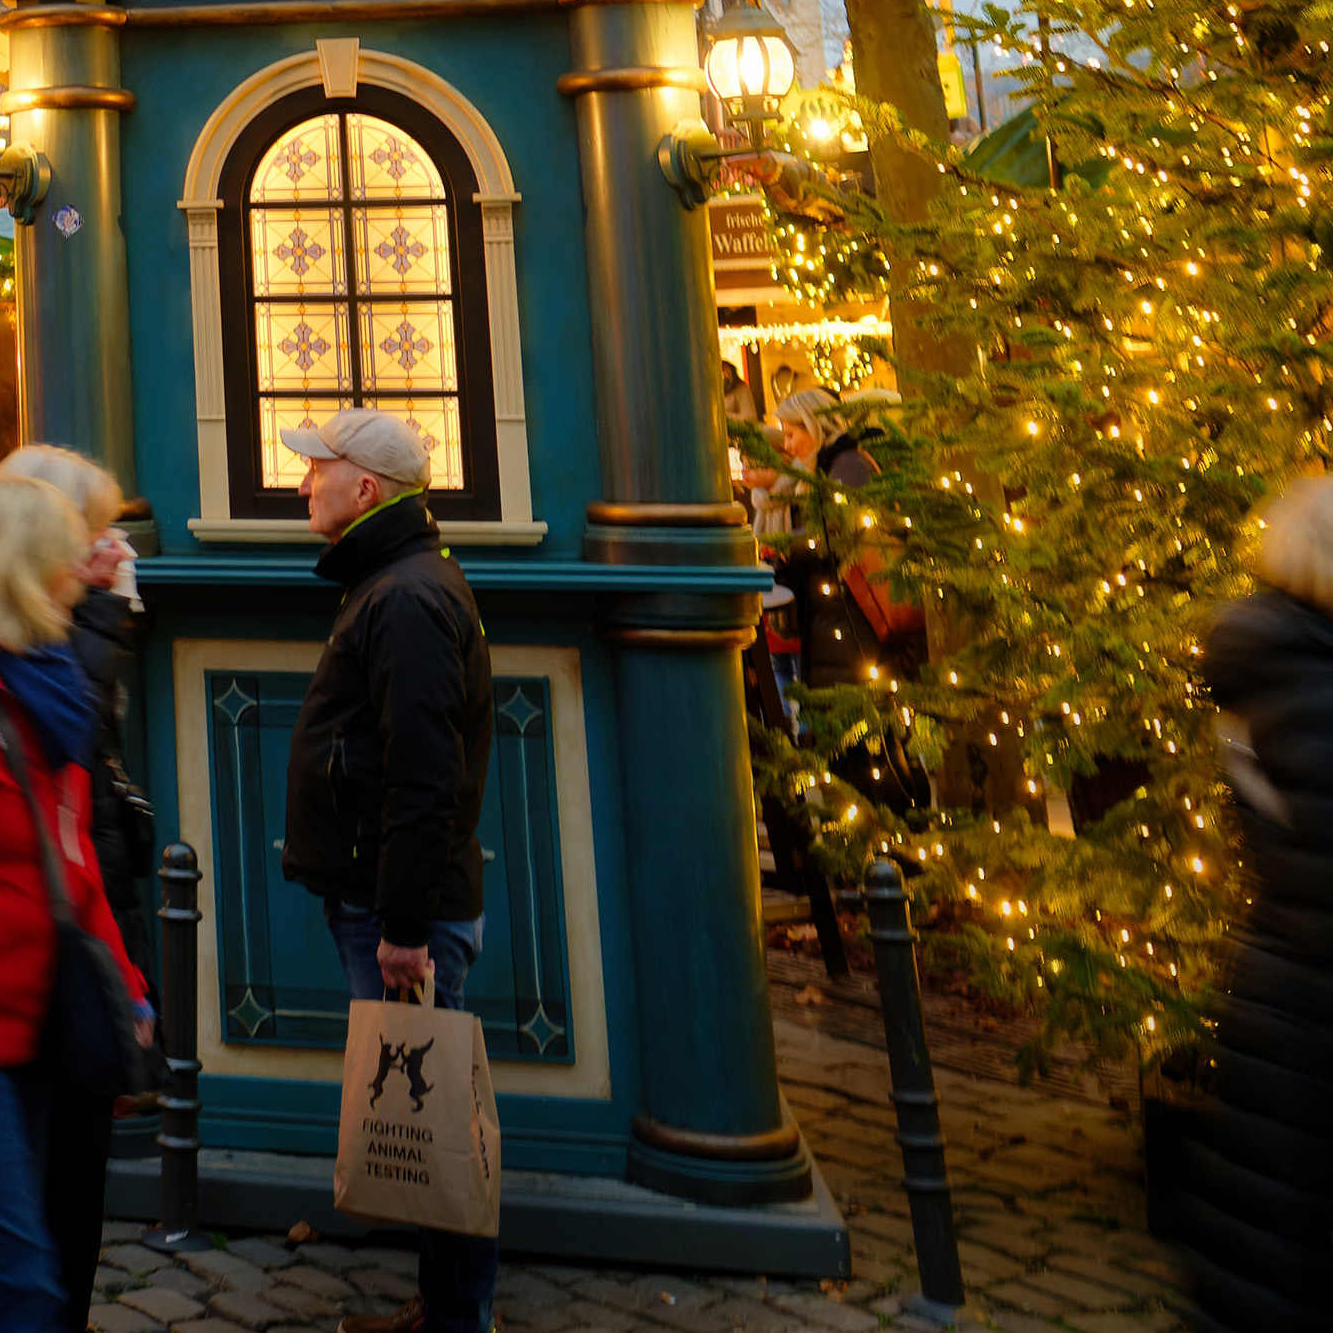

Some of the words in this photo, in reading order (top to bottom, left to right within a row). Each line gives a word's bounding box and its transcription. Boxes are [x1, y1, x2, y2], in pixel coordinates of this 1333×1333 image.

[725, 212, 764, 228] frische
[362, 1117, 434, 1143] FIGHTING
[367, 1141, 426, 1164] ANIMAL
[365, 1161, 430, 1185] TESTING
